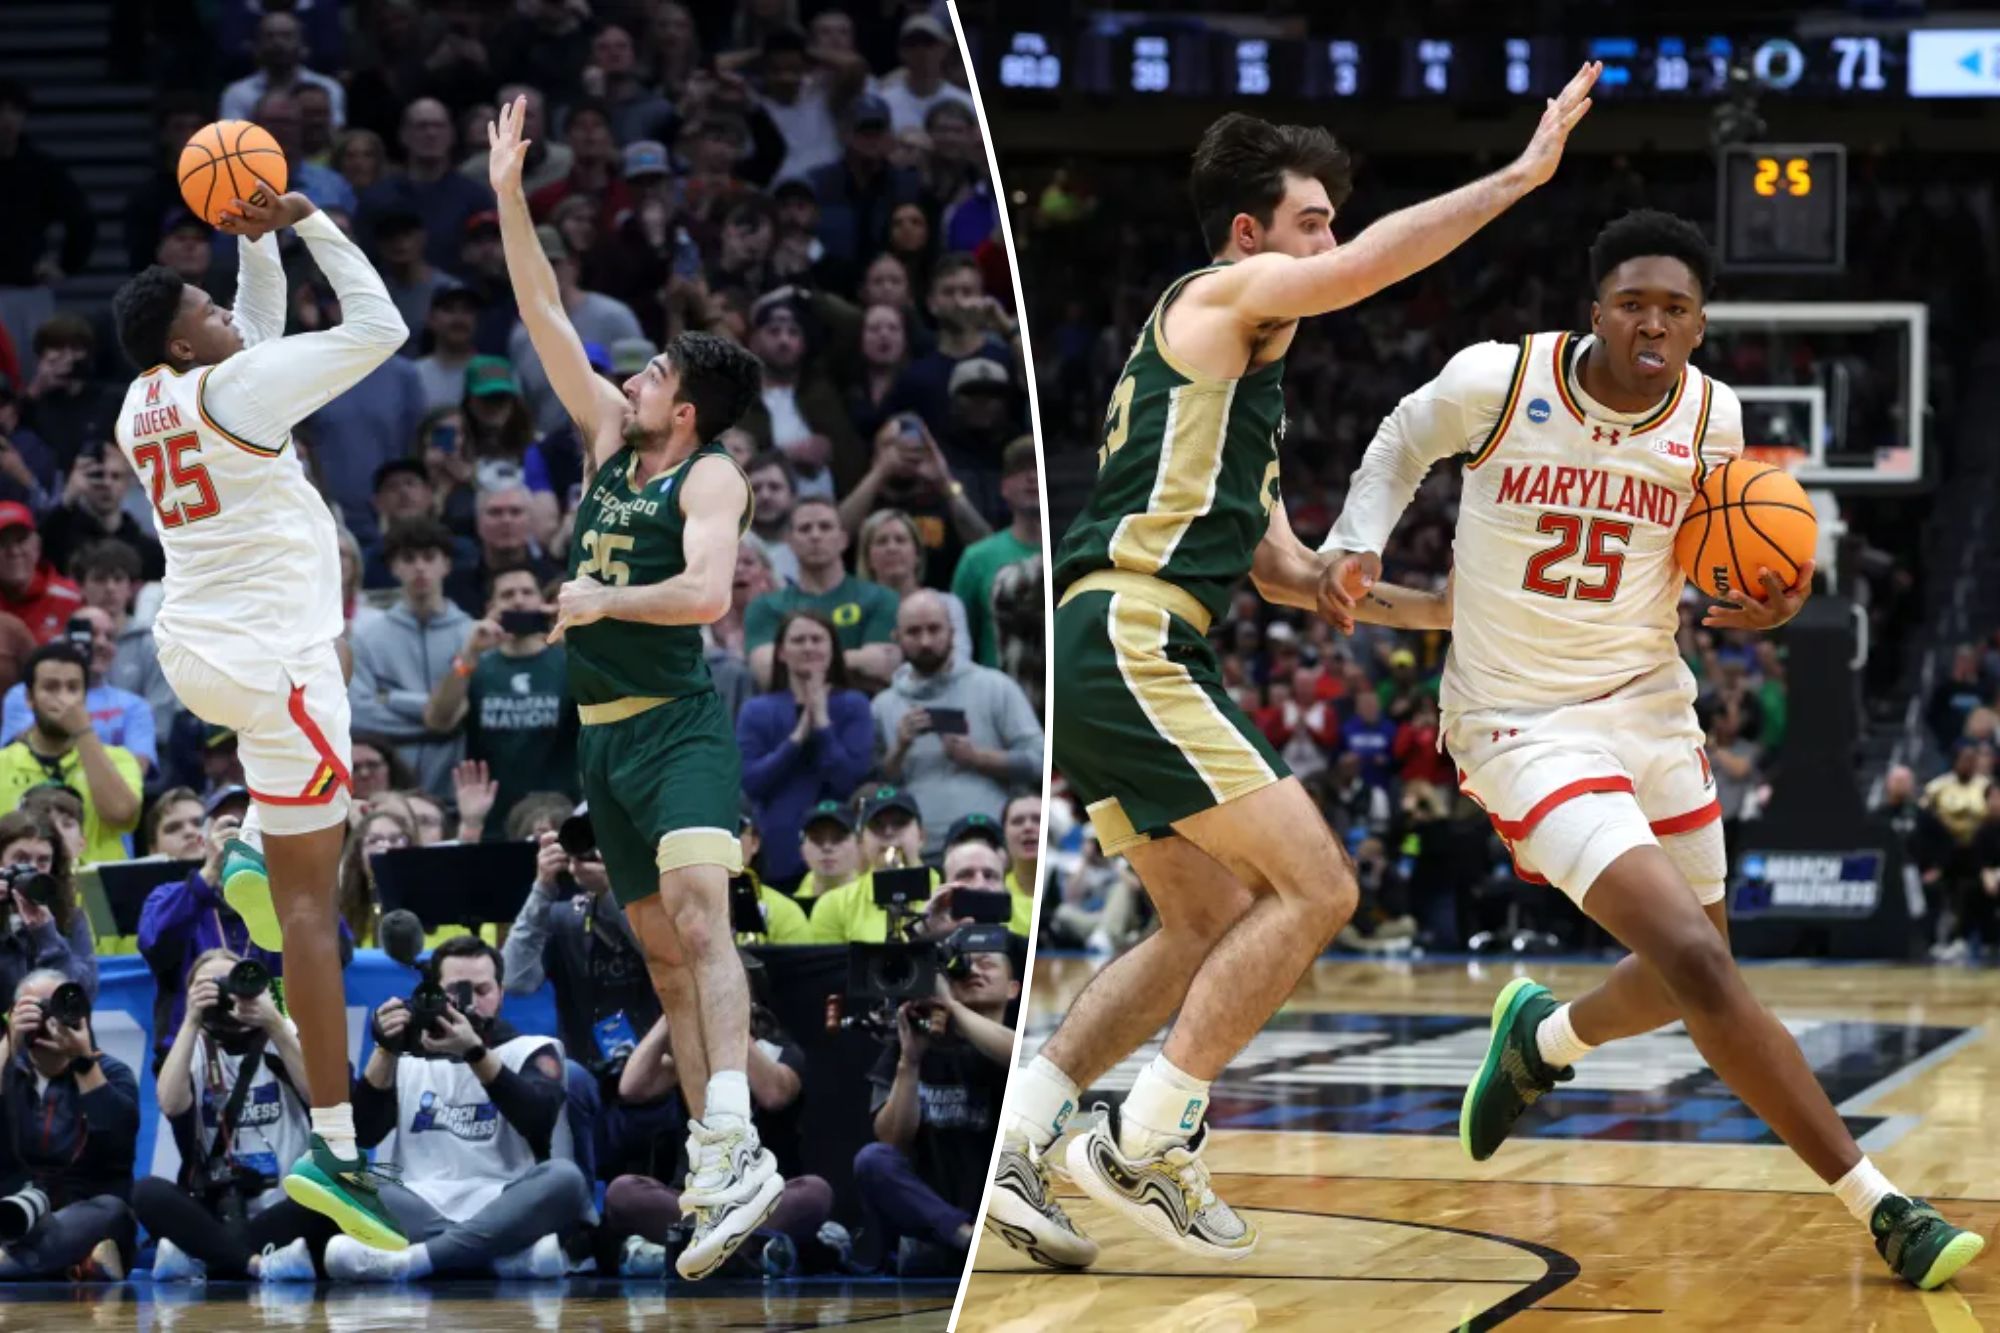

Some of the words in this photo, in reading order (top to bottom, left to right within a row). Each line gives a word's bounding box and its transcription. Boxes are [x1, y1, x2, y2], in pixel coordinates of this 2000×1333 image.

[1831, 37, 1885, 90] 71
[133, 404, 182, 438] QUEEN
[132, 429, 222, 530] 25
[1496, 465, 1679, 529] MARYLAND
[576, 528, 635, 587] 25
[1521, 512, 1634, 603] 25
[481, 710, 559, 728] NATION
[482, 696, 559, 711] SPARTAN
[1764, 856, 1842, 882] MARCH
